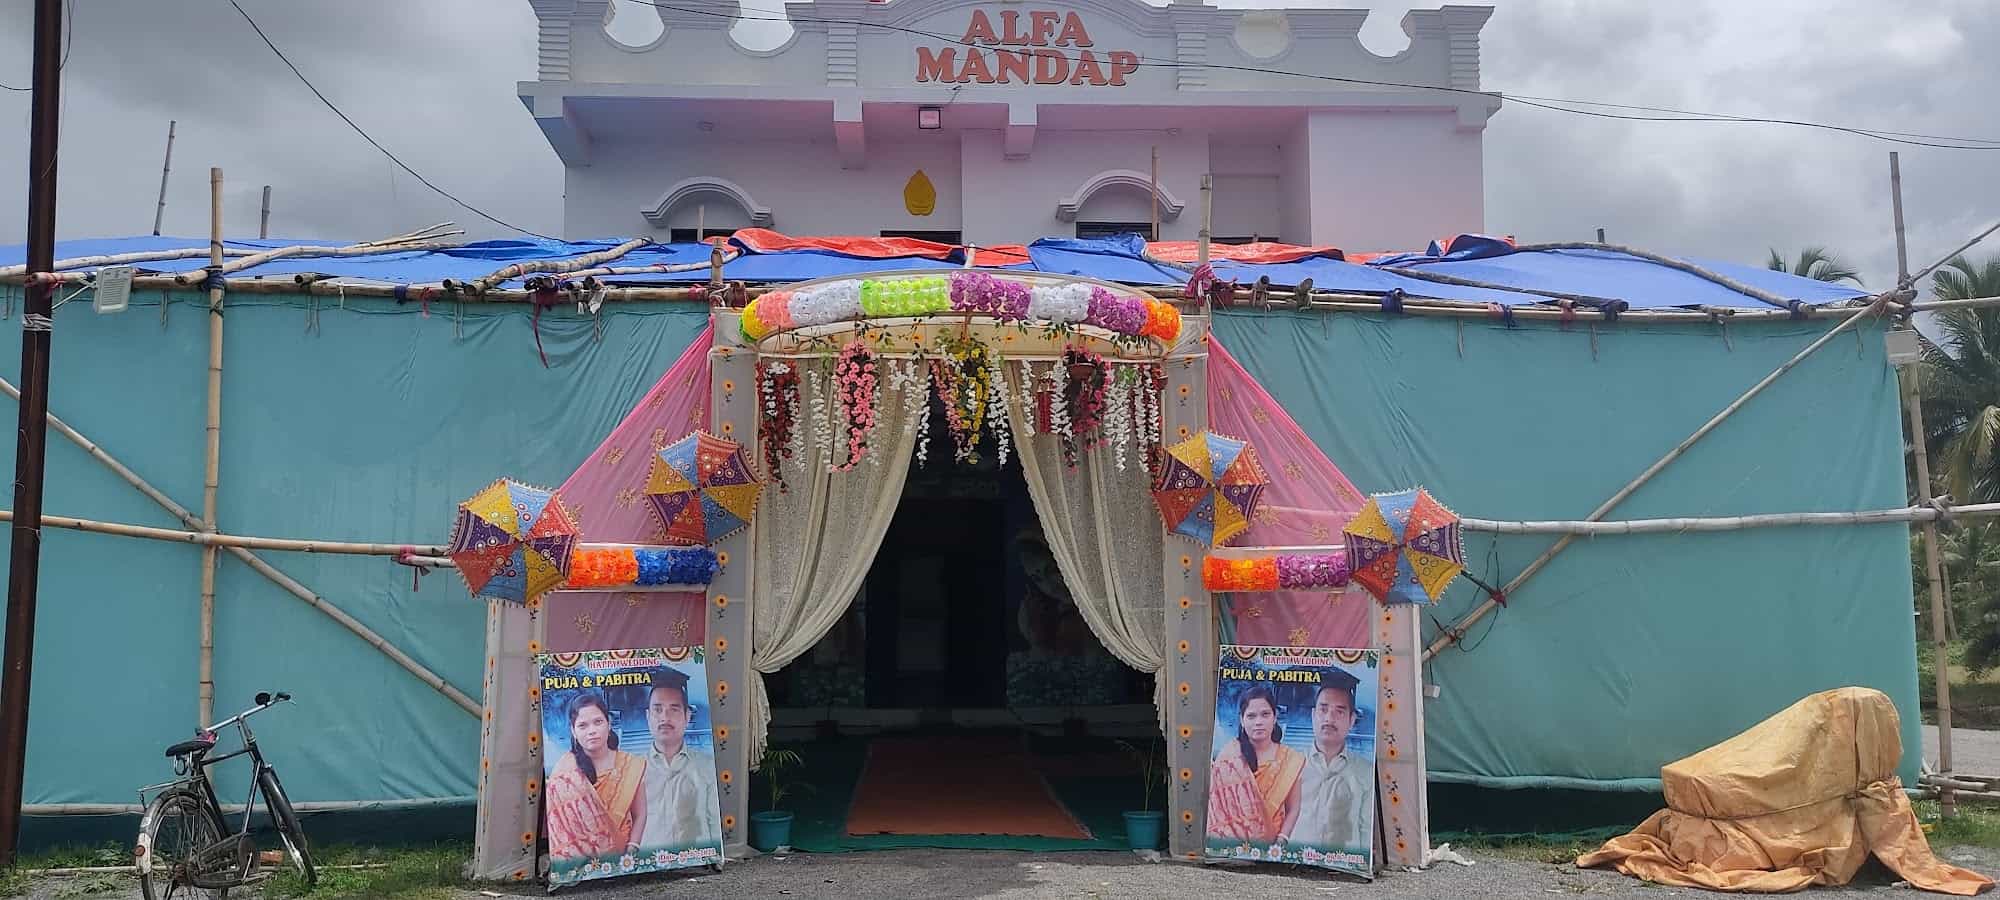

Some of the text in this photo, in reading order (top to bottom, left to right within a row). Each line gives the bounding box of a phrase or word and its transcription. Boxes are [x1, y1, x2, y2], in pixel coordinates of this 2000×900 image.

[961, 9, 1094, 47] ALFA
[916, 46, 1139, 86] MANDAP
[590, 657, 659, 669] HAPPY WEDDING
[1264, 656, 1331, 666] HAPPY WEDDING
[544, 672, 651, 690] PUJA & PABITRA
[1222, 668, 1321, 683] PUJA & PABITRA
